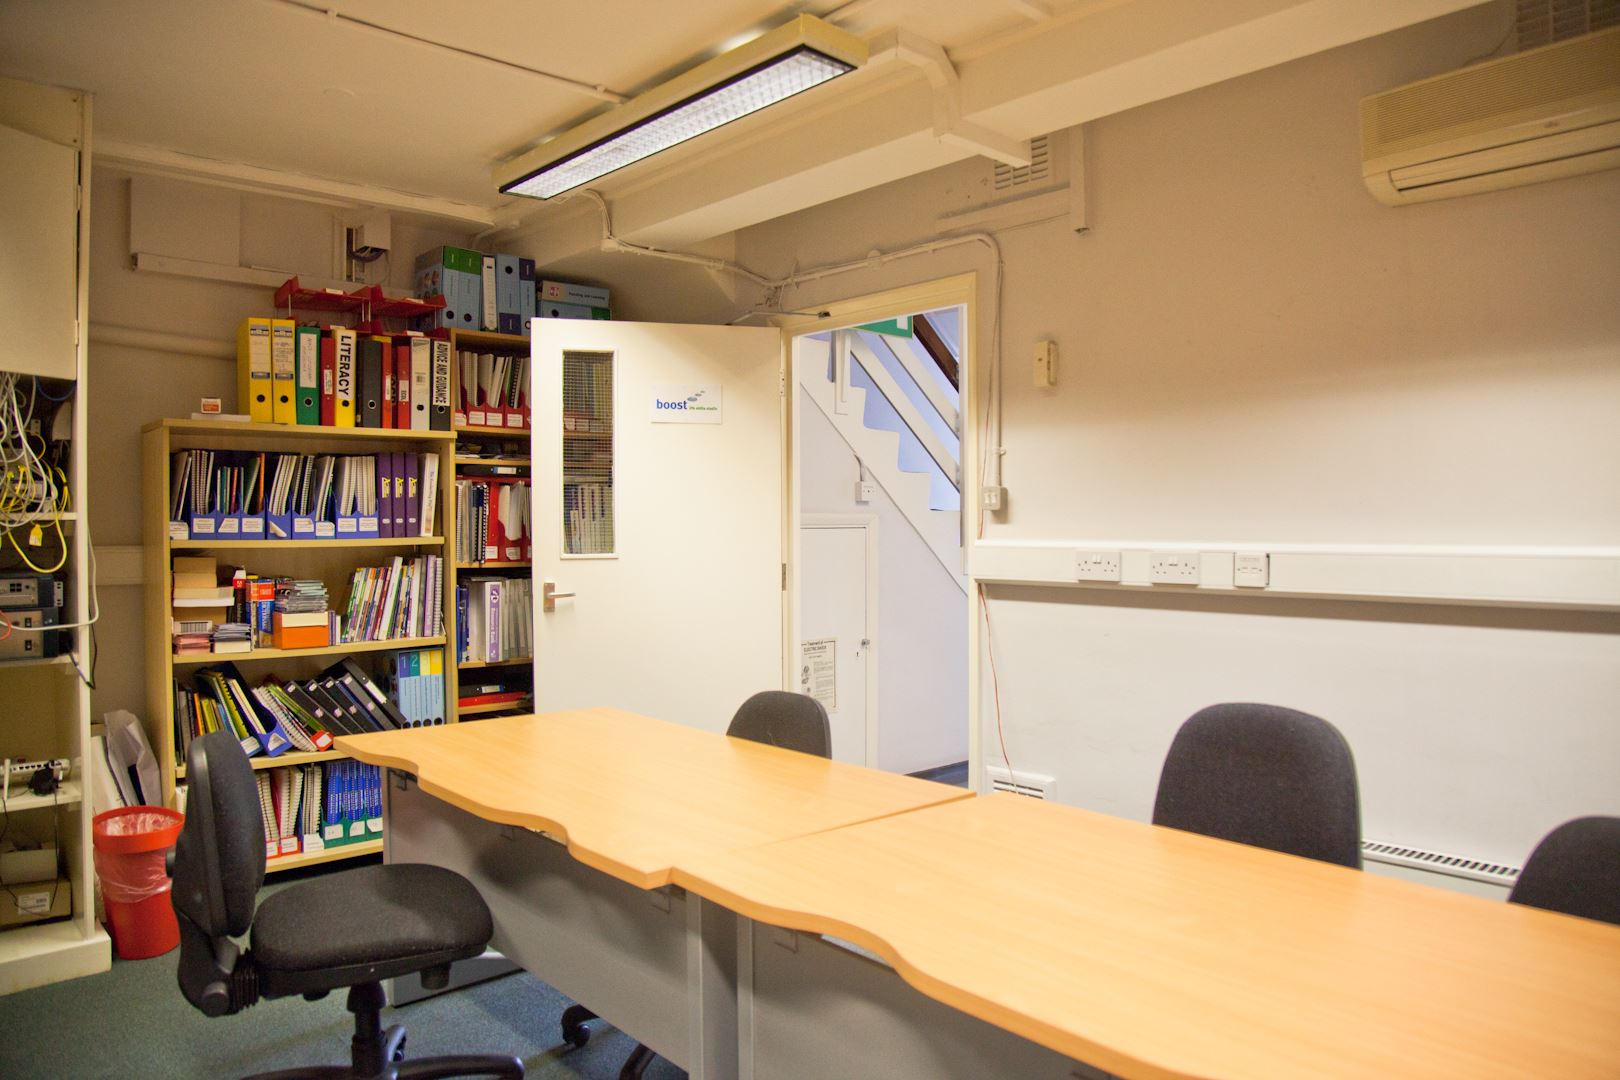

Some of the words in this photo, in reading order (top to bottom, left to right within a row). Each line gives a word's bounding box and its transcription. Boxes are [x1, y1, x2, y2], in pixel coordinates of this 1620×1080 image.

[436, 343, 448, 363] ADVICE
[339, 335, 352, 396] LITERACY
[436, 364, 448, 375] AND
[435, 376, 447, 404] GUIDANCE
[656, 399, 687, 410] boost
[411, 655, 418, 667] 2
